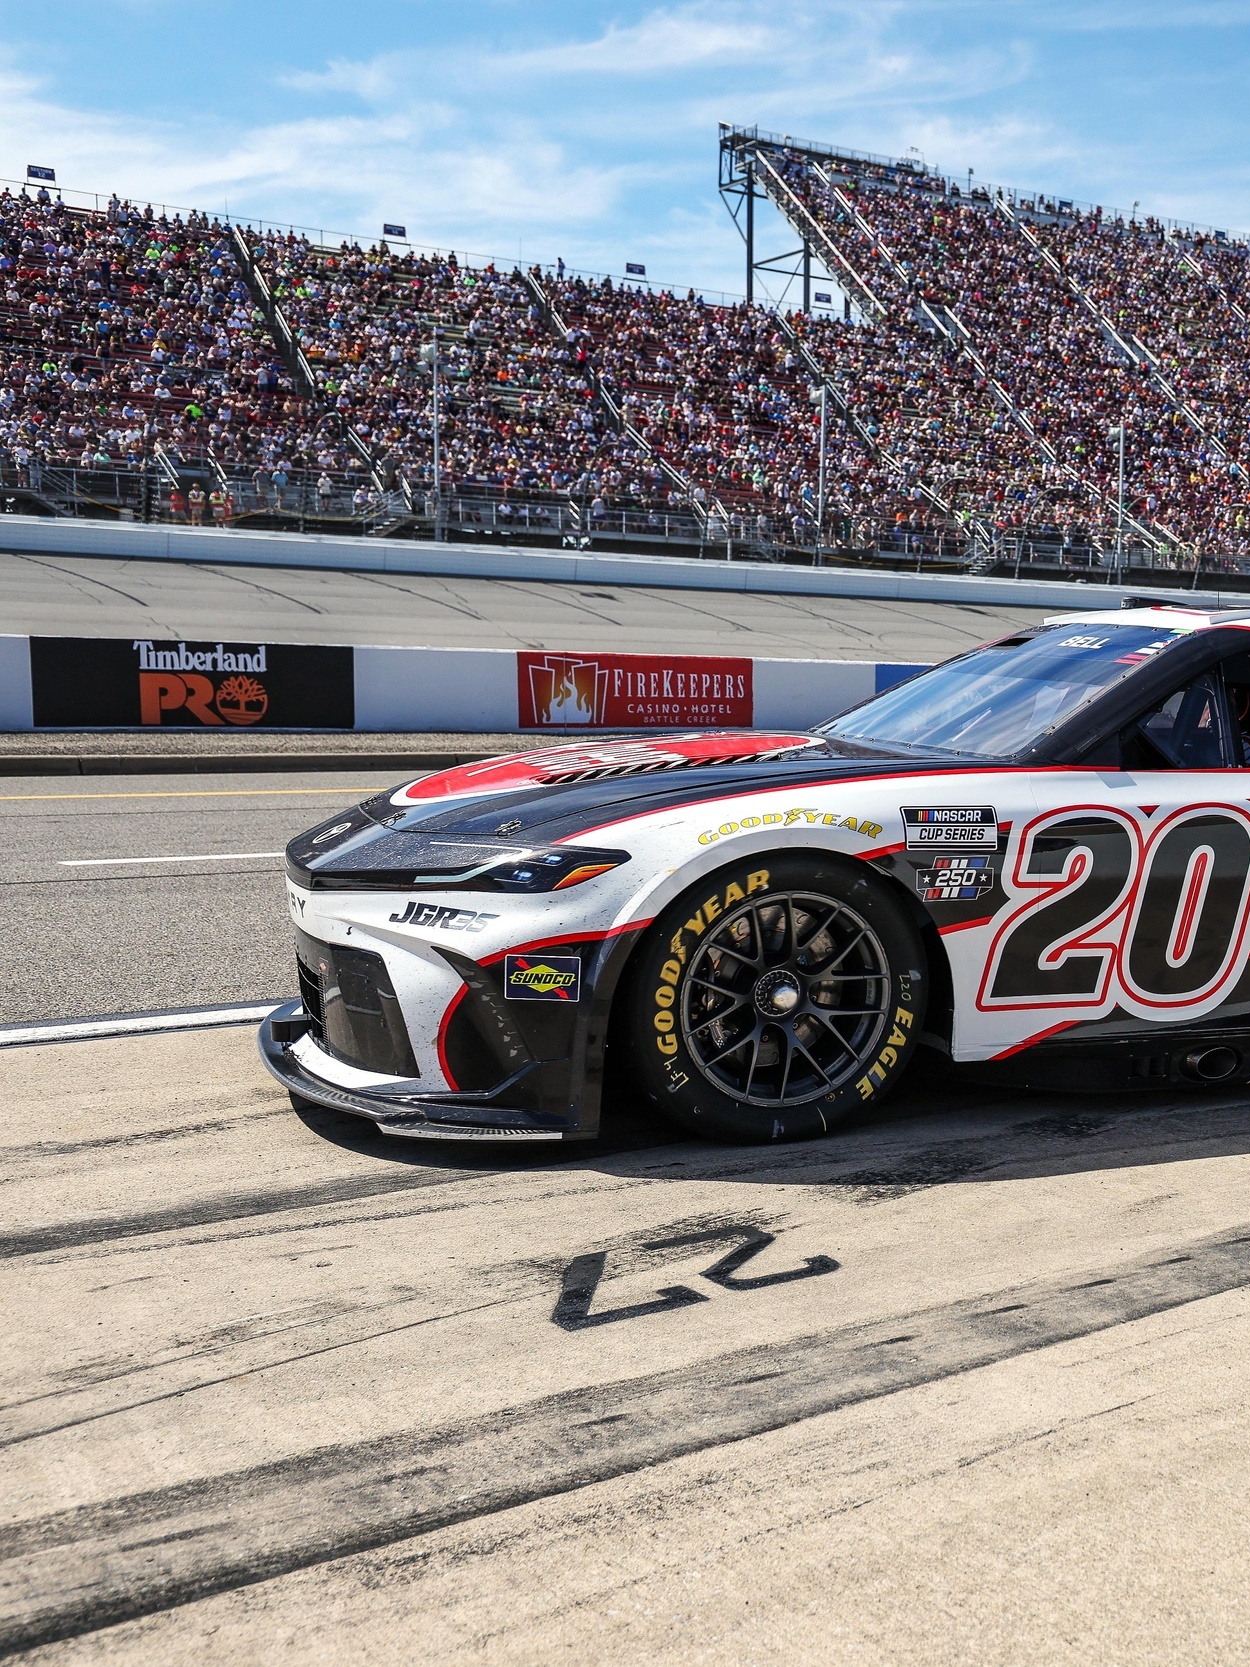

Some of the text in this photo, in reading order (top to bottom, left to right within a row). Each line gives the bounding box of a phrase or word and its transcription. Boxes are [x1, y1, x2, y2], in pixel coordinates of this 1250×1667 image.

[1057, 635, 1111, 649] BELL
[133, 640, 267, 673] Timberland
[627, 703, 732, 715] CASINO HOTEL
[643, 715, 717, 724] BATTLE CREEK
[933, 810, 982, 822] NASCAR
[697, 808, 884, 846] GOODYEAR
[919, 827, 986, 841] CUP SERIES
[935, 869, 977, 887] 250
[508, 970, 576, 988] SUNOCO
[855, 1006, 914, 1100] EAGLE
